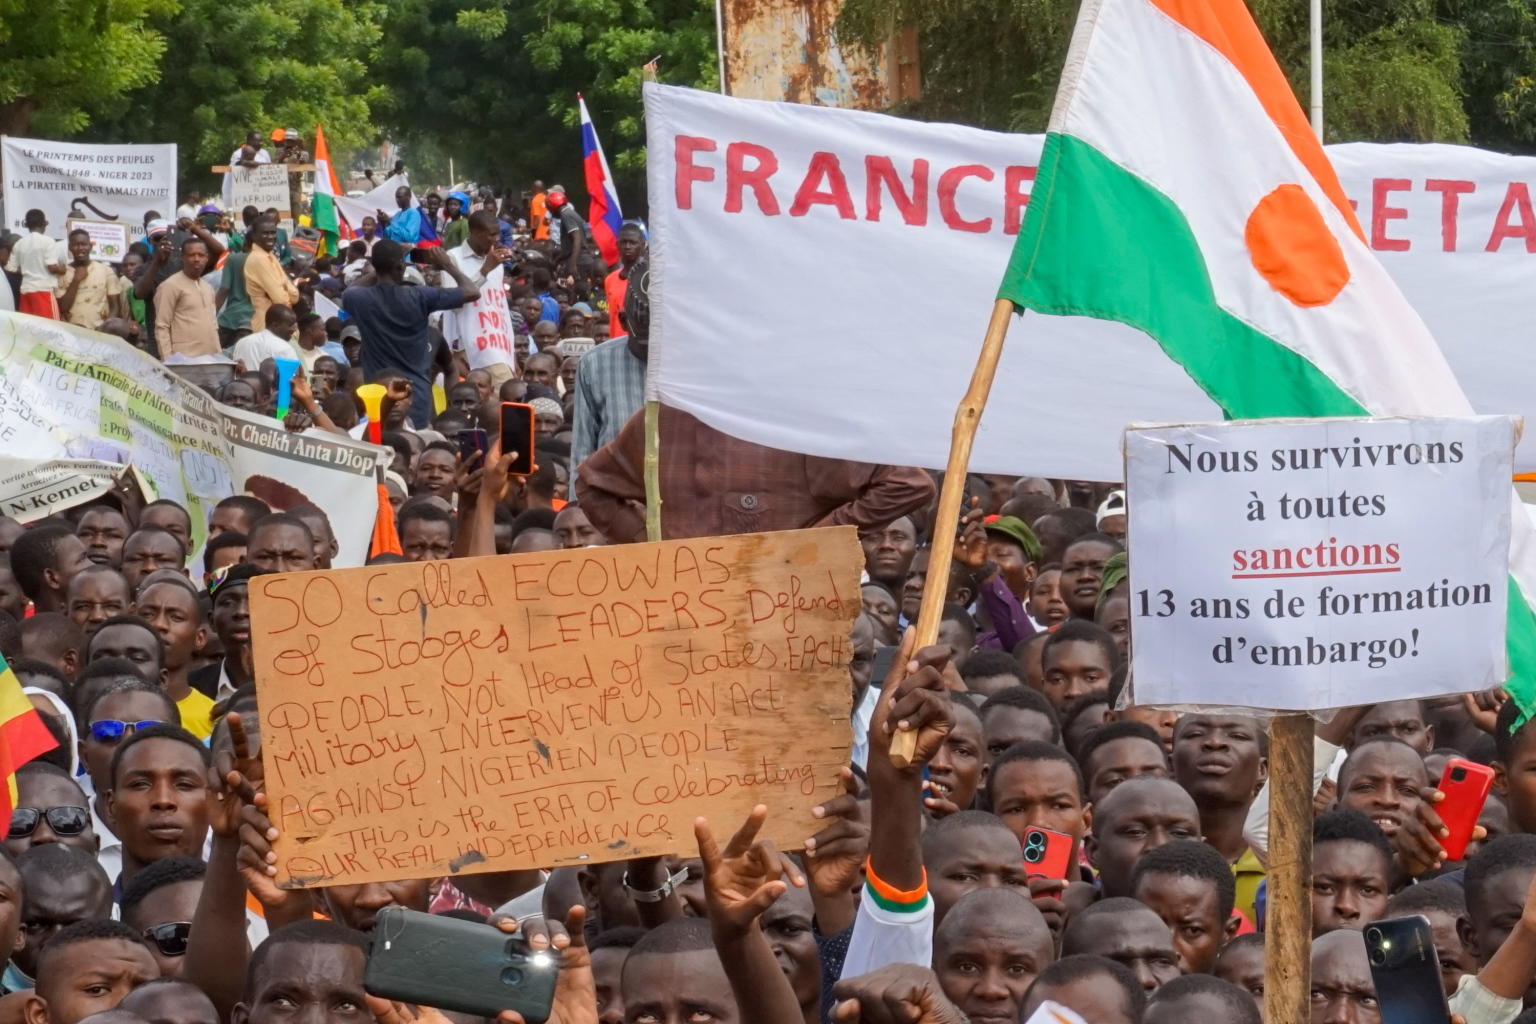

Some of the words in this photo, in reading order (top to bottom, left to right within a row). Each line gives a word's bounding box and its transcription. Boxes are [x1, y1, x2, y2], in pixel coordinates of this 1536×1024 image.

[37, 150, 95, 164] PRINTEMPS
[96, 156, 115, 164] DES
[117, 156, 155, 165] PEUPLES
[67, 169, 91, 178] 1848
[98, 172, 128, 181] NIGER
[130, 172, 153, 181] 2023
[12, 180, 25, 189] LA
[27, 181, 76, 192] PIRATERIE
[674, 134, 1038, 235] FRANCE
[45, 350, 72, 370] Par
[130, 384, 142, 400] de
[222, 417, 239, 439] Pr.
[241, 424, 289, 455] Cheikh
[292, 438, 331, 463] Anta
[334, 446, 374, 476] Diop
[1164, 442, 1258, 474] Nous
[1271, 436, 1464, 472] survivrons
[9, 477, 99, 515] N-Kemet
[1246, 495, 1266, 522] à
[1280, 490, 1386, 521] toutes
[1232, 537, 1401, 571] sanctions
[263, 575, 343, 635] SO
[366, 562, 493, 616] Called
[512, 546, 731, 601] ECOWAS
[1136, 588, 1176, 618] 13
[1190, 596, 1250, 620] ans
[1263, 589, 1306, 619] de
[1317, 578, 1492, 617] formation
[351, 618, 510, 688] Stooges
[746, 570, 848, 634] Defend
[1212, 628, 1421, 669] d'embargo!
[520, 655, 598, 707] Head
[787, 634, 844, 672] EACH
[677, 680, 716, 719] AN
[608, 723, 741, 773] PEOPLE
[513, 793, 576, 829] ERA
[586, 785, 622, 812] OF
[632, 755, 816, 806] Celebrating
[373, 844, 445, 876] REAL
